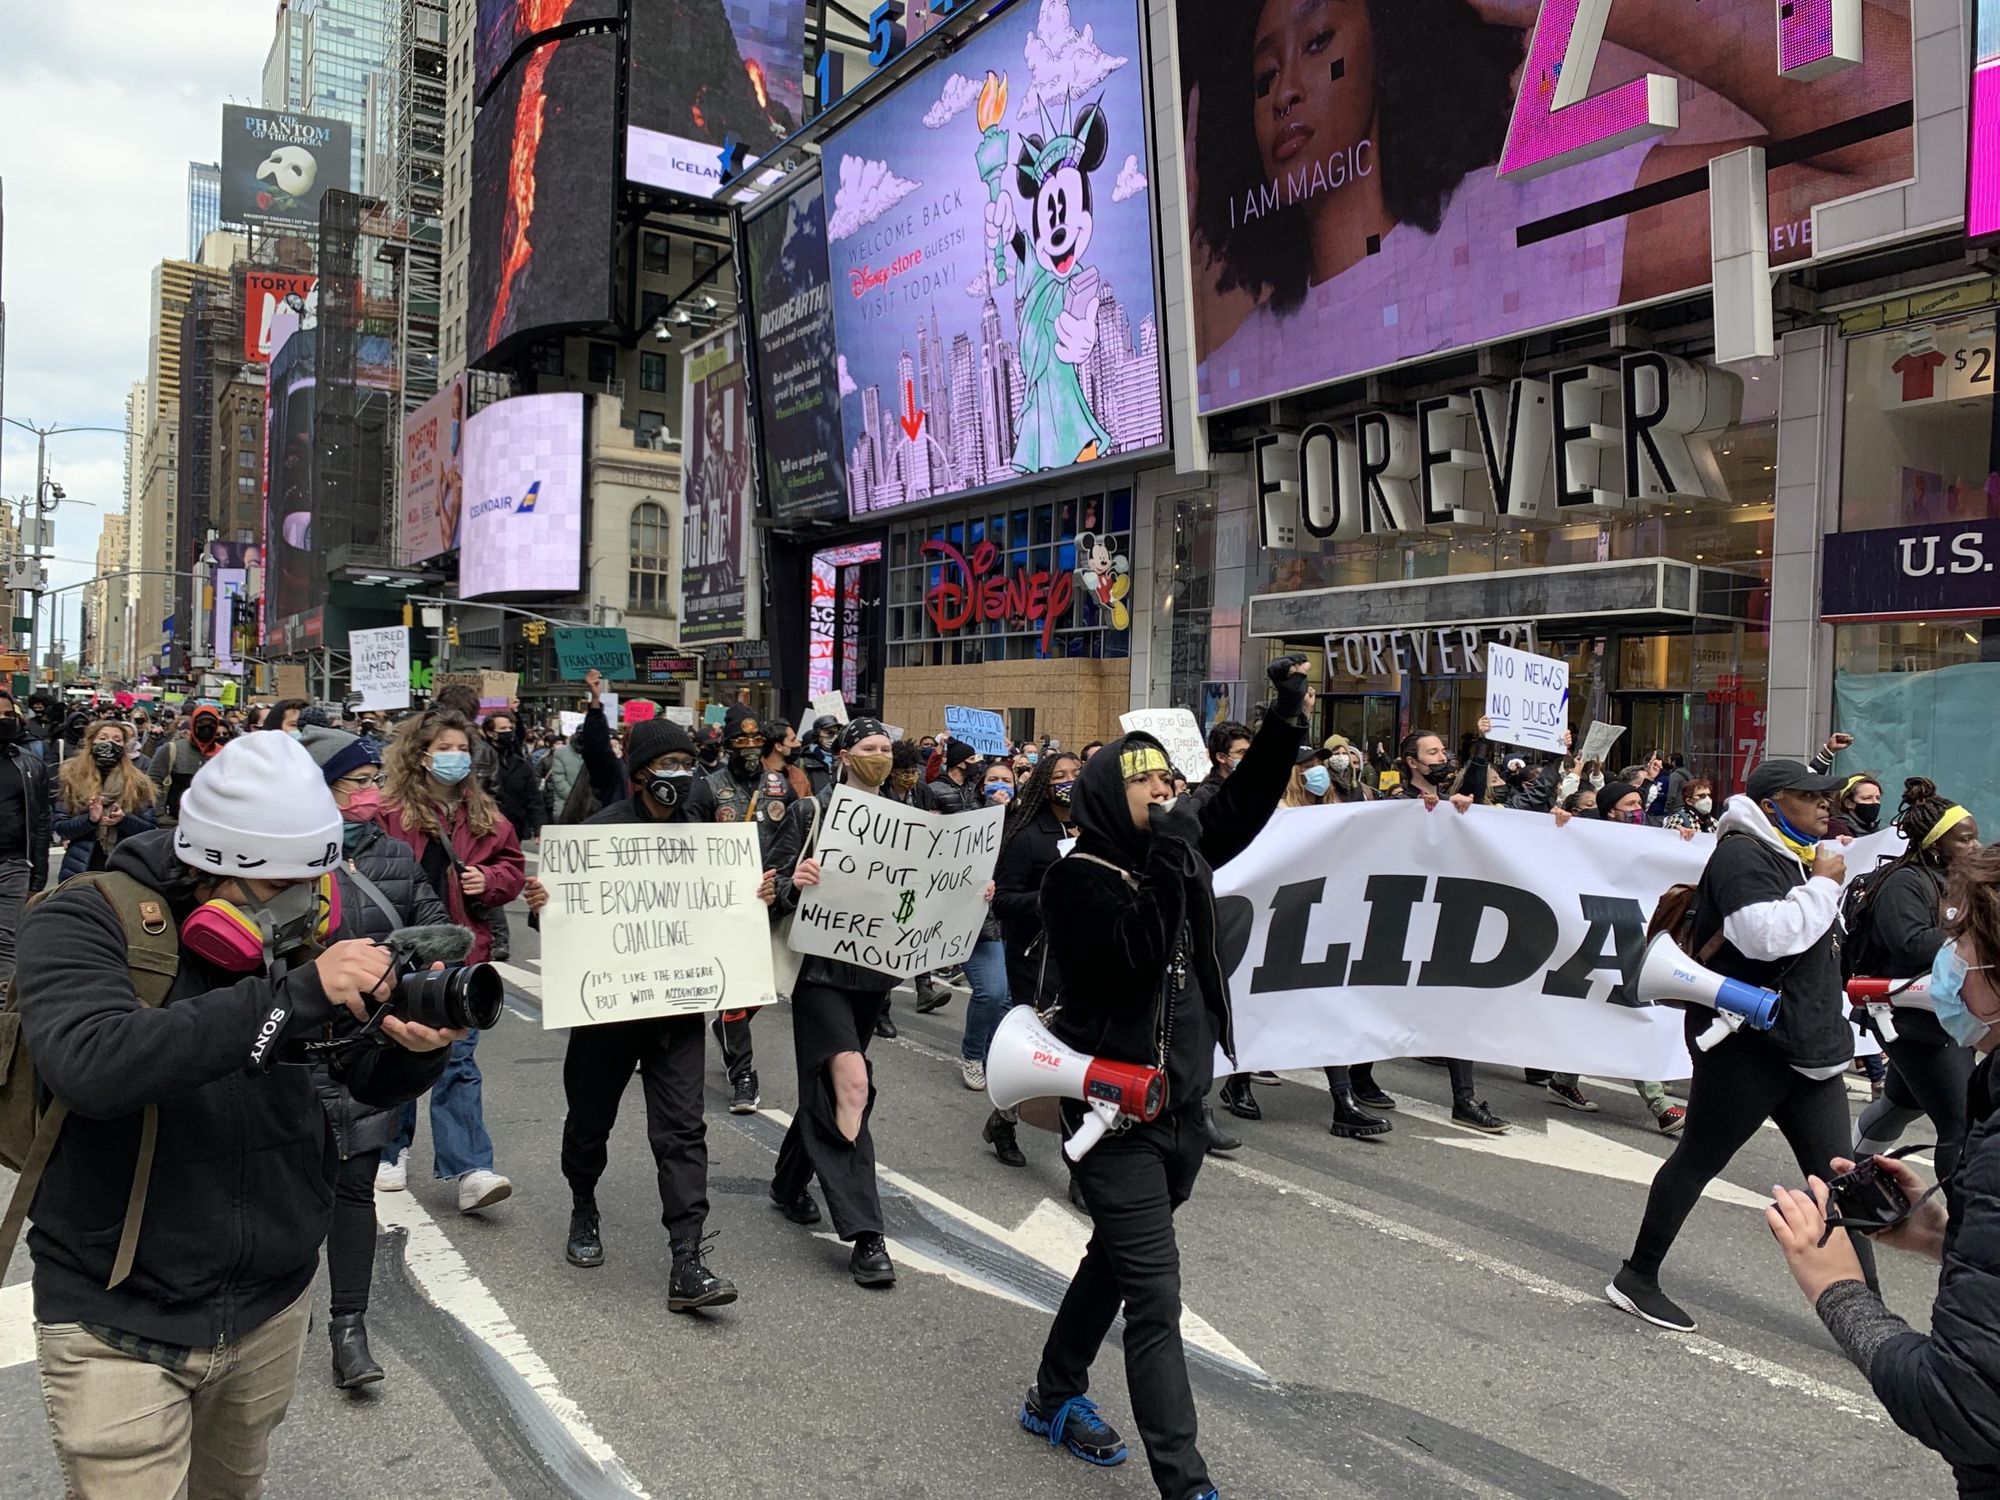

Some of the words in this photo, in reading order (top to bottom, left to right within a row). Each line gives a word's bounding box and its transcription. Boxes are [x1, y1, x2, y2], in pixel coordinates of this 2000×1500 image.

[245, 117, 330, 141] PHANTOM
[278, 115, 299, 125] THE
[252, 130, 266, 139] OF
[269, 133, 288, 142] THE
[289, 136, 322, 147] OPERA
[671, 157, 721, 179] ICELAN
[1230, 196, 1236, 229] I
[1243, 177, 1280, 225] AM
[1287, 139, 1373, 206] MAGIC
[848, 214, 914, 264] WELCOME
[922, 189, 963, 227] BACK
[891, 249, 922, 277] store
[924, 226, 966, 260] GUESTS!
[250, 277, 297, 292] TORY
[861, 290, 896, 321] VISIT
[903, 261, 957, 303] TODAY!
[760, 282, 825, 339] INSUREARTH
[1253, 350, 1680, 549] FOREVER
[1899, 532, 1994, 577] U.S.
[374, 630, 405, 642] TIRED
[584, 629, 616, 640] CALL
[1324, 625, 1484, 678] FOREVER
[361, 650, 400, 663] HAPPY
[369, 661, 395, 674] MEN
[1494, 654, 1514, 679] NO
[1524, 661, 1564, 691] NEWS
[945, 706, 1001, 732] EQUITY
[1492, 693, 1511, 717] NO
[1522, 687, 1568, 727] DUES!
[541, 838, 604, 873] REMOVE
[706, 837, 754, 867] FROM
[954, 821, 997, 858] TIME
[820, 848, 856, 873] TO
[868, 860, 918, 887] PUT
[925, 865, 973, 898] YOUR
[557, 881, 593, 914] THE
[601, 880, 680, 915] BROADWAY
[686, 877, 741, 910] LEAGUE
[892, 889, 915, 924] $
[612, 919, 694, 954] CHALLENGE
[801, 903, 884, 938] WHERE
[895, 920, 942, 949] YOUR
[833, 939, 927, 971] MOUTH
[941, 930, 973, 959] IS!
[622, 973, 648, 985] LIKE
[652, 970, 671, 982] THE
[674, 966, 714, 981] RENEGADE
[595, 993, 620, 1010] BUT
[630, 988, 655, 1005] WITH
[251, 1008, 286, 1064] SONY
[1033, 1051, 1061, 1067] PYLE
